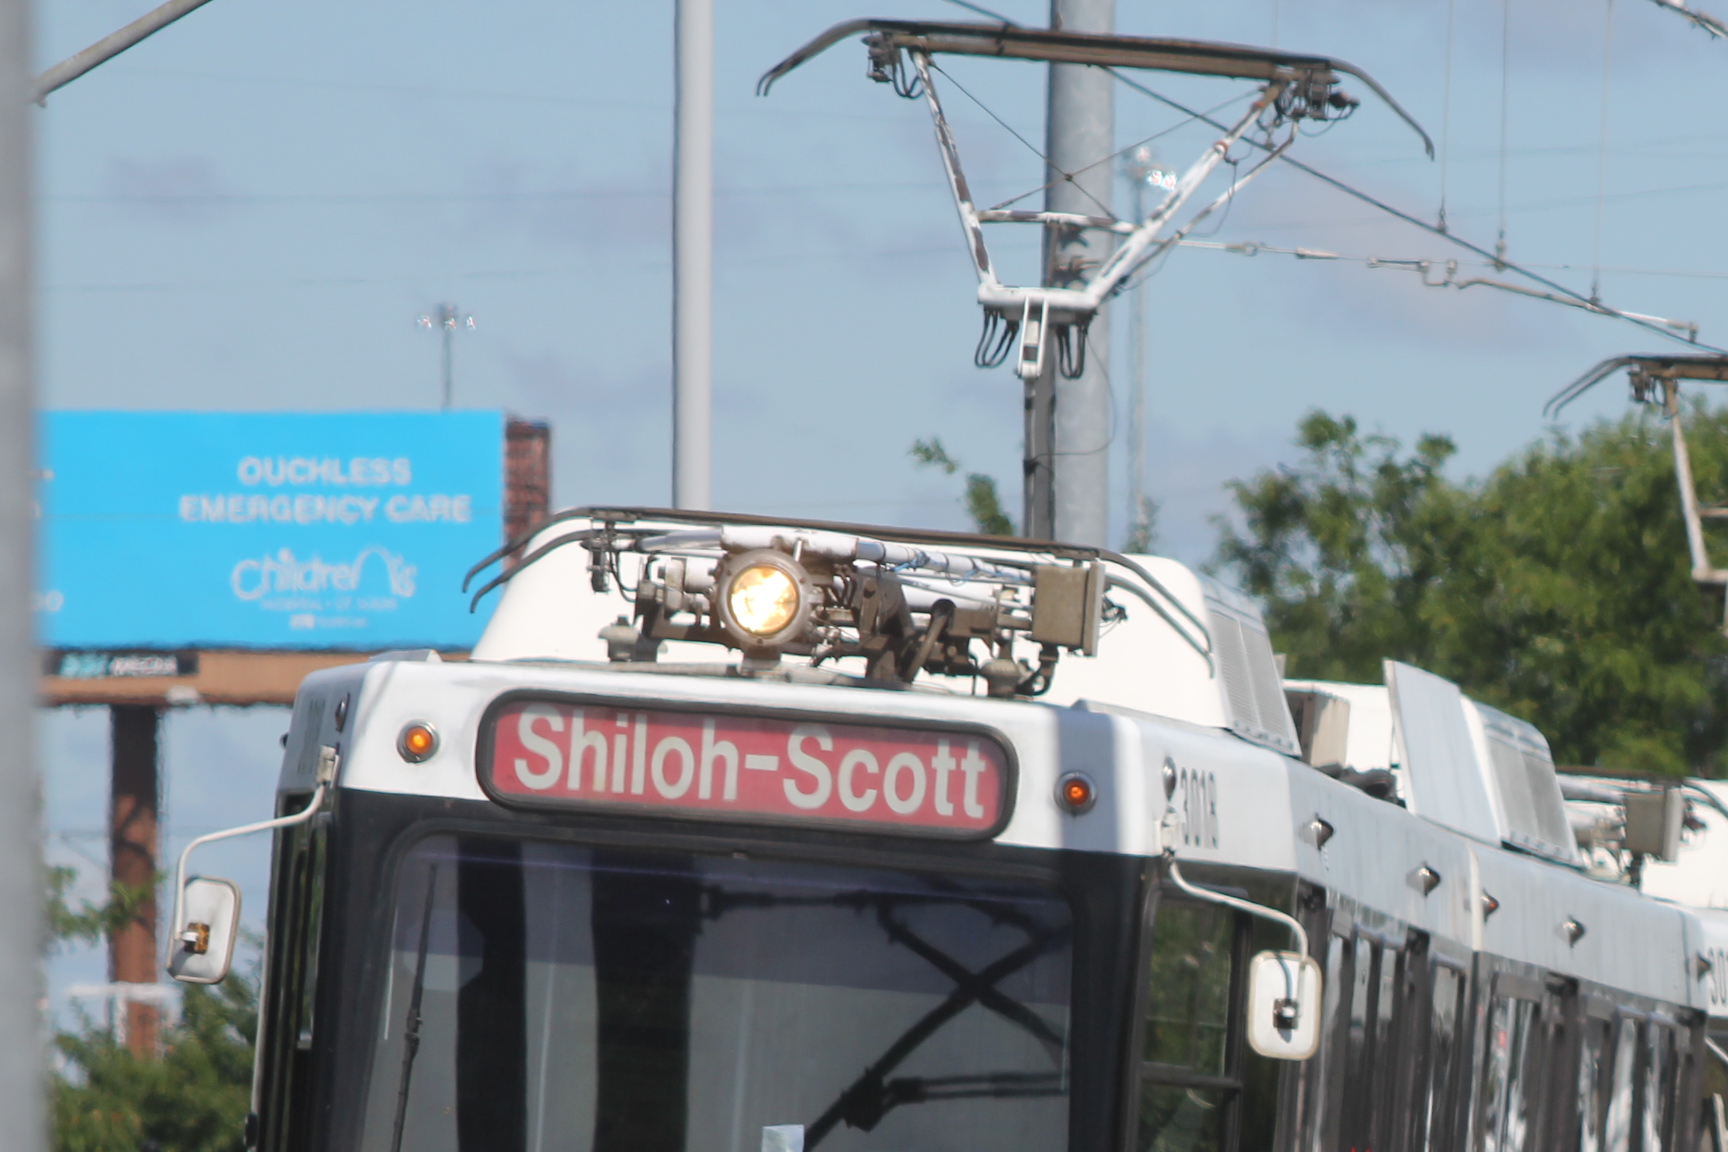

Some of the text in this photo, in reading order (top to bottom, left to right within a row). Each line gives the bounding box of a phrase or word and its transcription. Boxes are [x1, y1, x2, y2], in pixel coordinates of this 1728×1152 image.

[237, 456, 412, 485] OUCHLESS
[180, 495, 472, 523] EMERGENCY CARE
[514, 704, 986, 819] Shiloh-Scott
